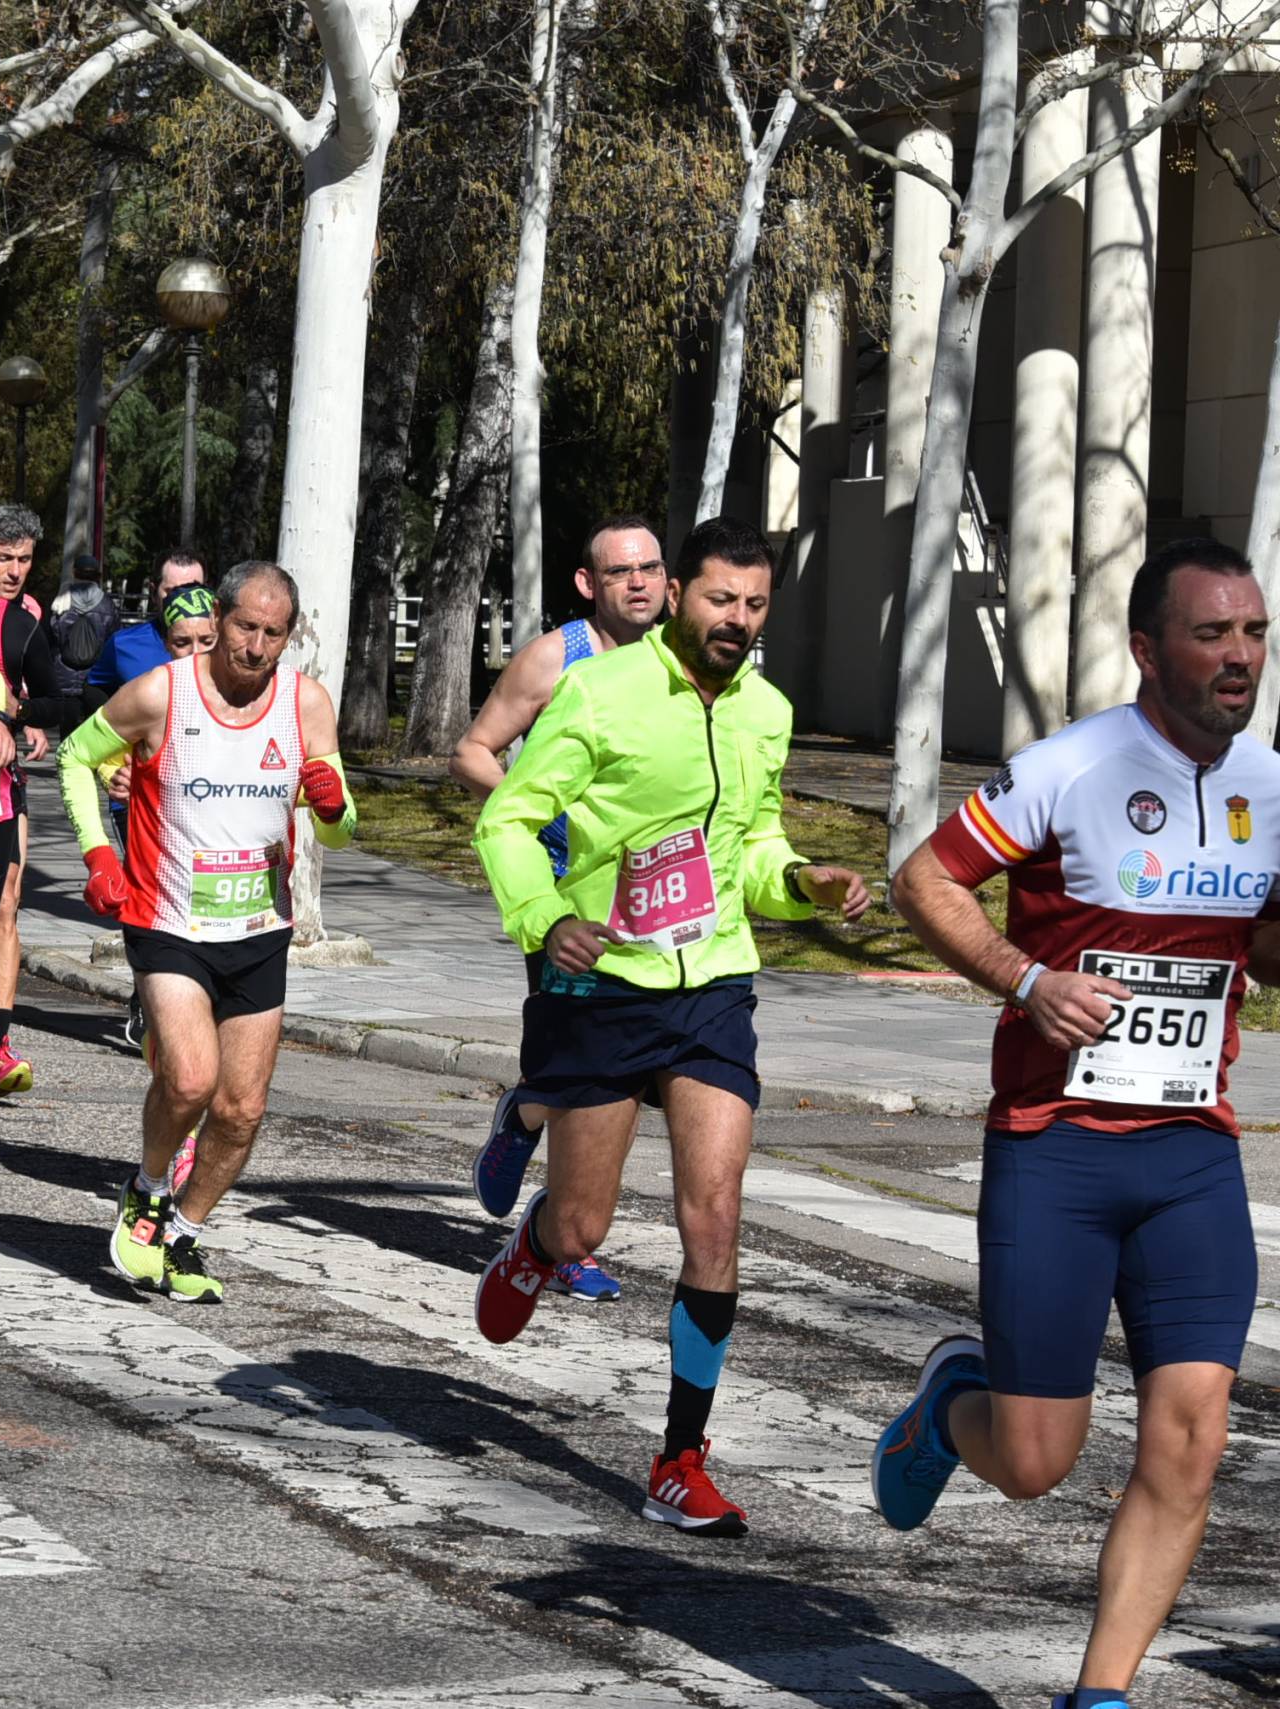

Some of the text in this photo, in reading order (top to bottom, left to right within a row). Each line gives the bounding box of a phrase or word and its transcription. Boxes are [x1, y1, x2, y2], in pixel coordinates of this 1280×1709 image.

[628, 832, 695, 869] OLISS
[215, 876, 265, 904] 966
[628, 871, 687, 917] 348
[1125, 984, 1151, 992] guros
[1155, 985, 1183, 994] desde
[1095, 1003, 1207, 1048] 2650
[1096, 1074, 1136, 1087] KODA
